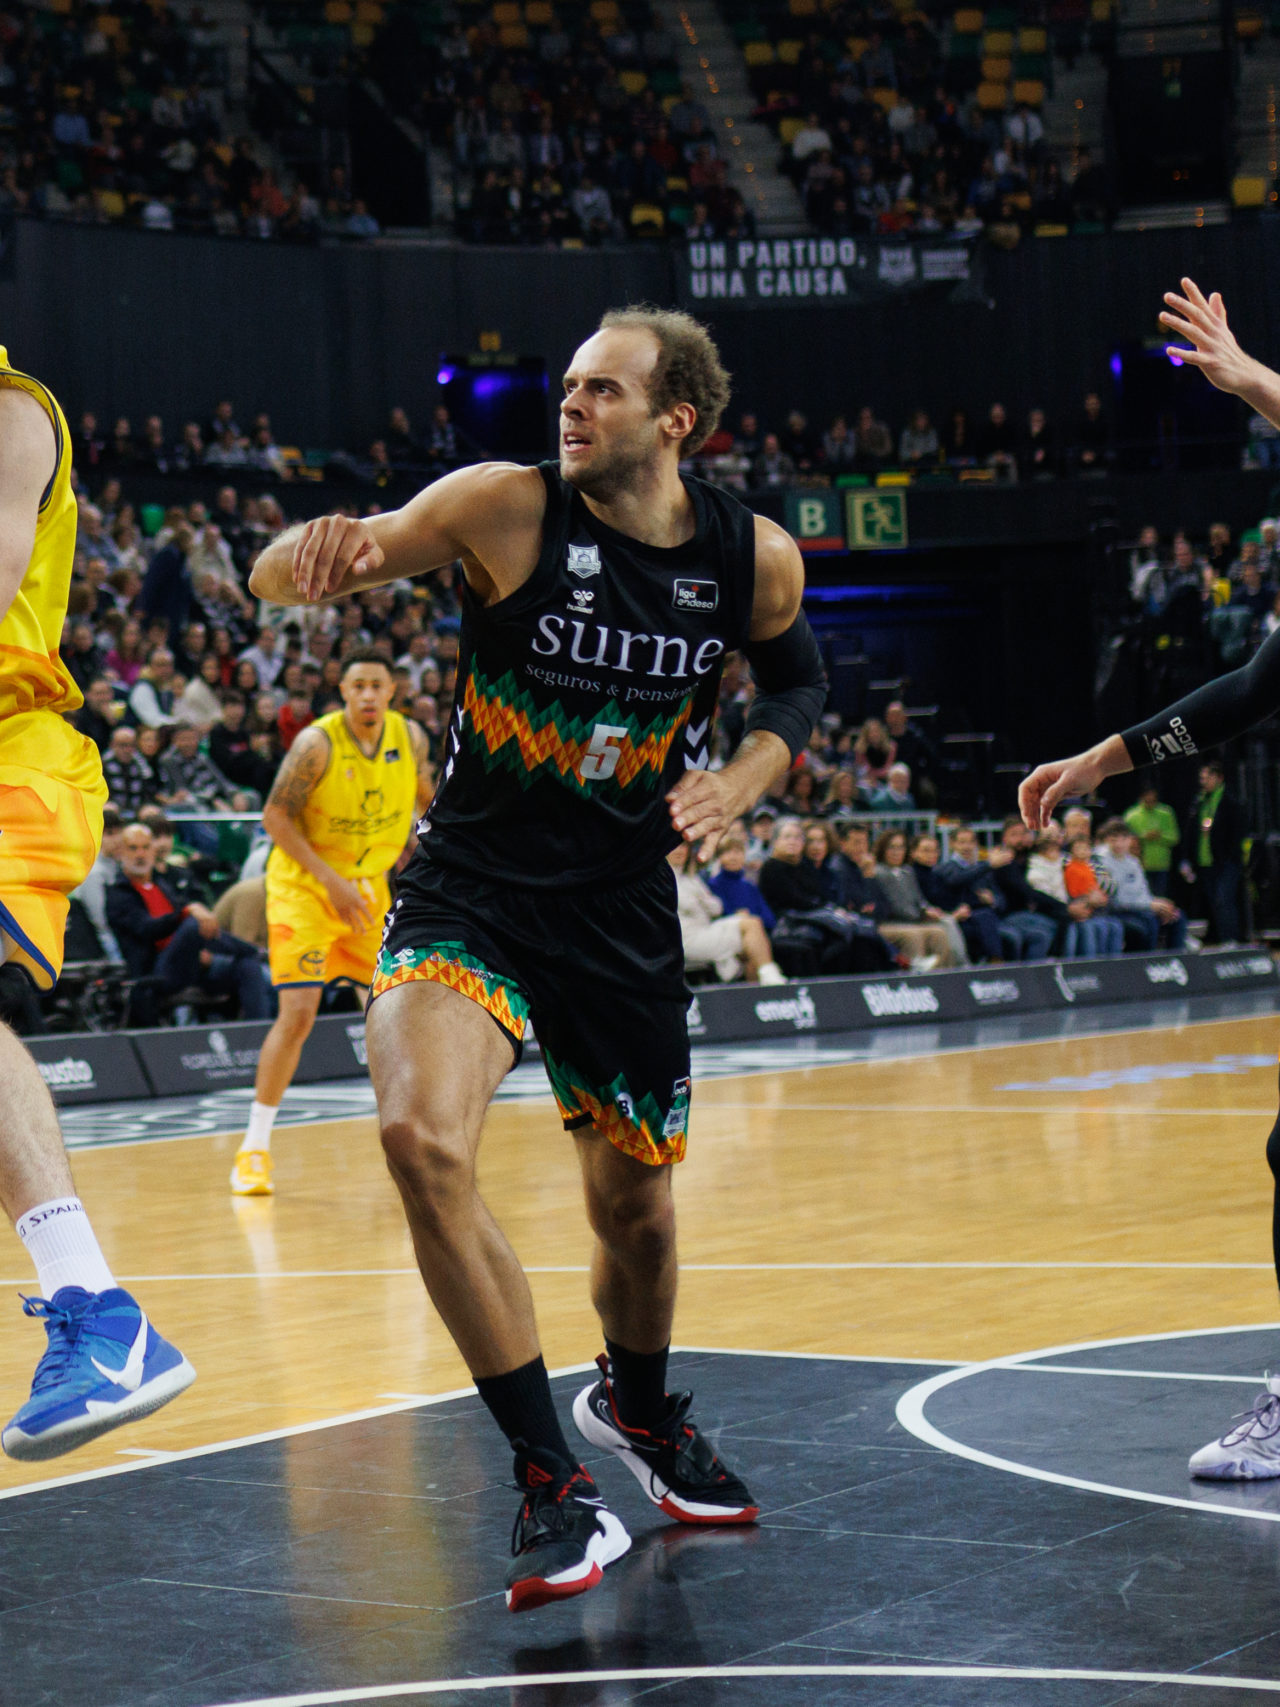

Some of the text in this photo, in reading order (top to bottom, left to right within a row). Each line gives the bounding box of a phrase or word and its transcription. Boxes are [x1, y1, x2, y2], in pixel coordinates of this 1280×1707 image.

[690, 242, 726, 268] UN
[737, 238, 867, 268] PARTIDO,
[690, 269, 848, 298] UNA CAUSA
[799, 498, 827, 537] B
[677, 599, 714, 609] endesa
[678, 588, 697, 600] liga
[531, 614, 724, 677] surne
[524, 663, 601, 694] seguros
[606, 684, 621, 697] &
[579, 723, 629, 780] 5
